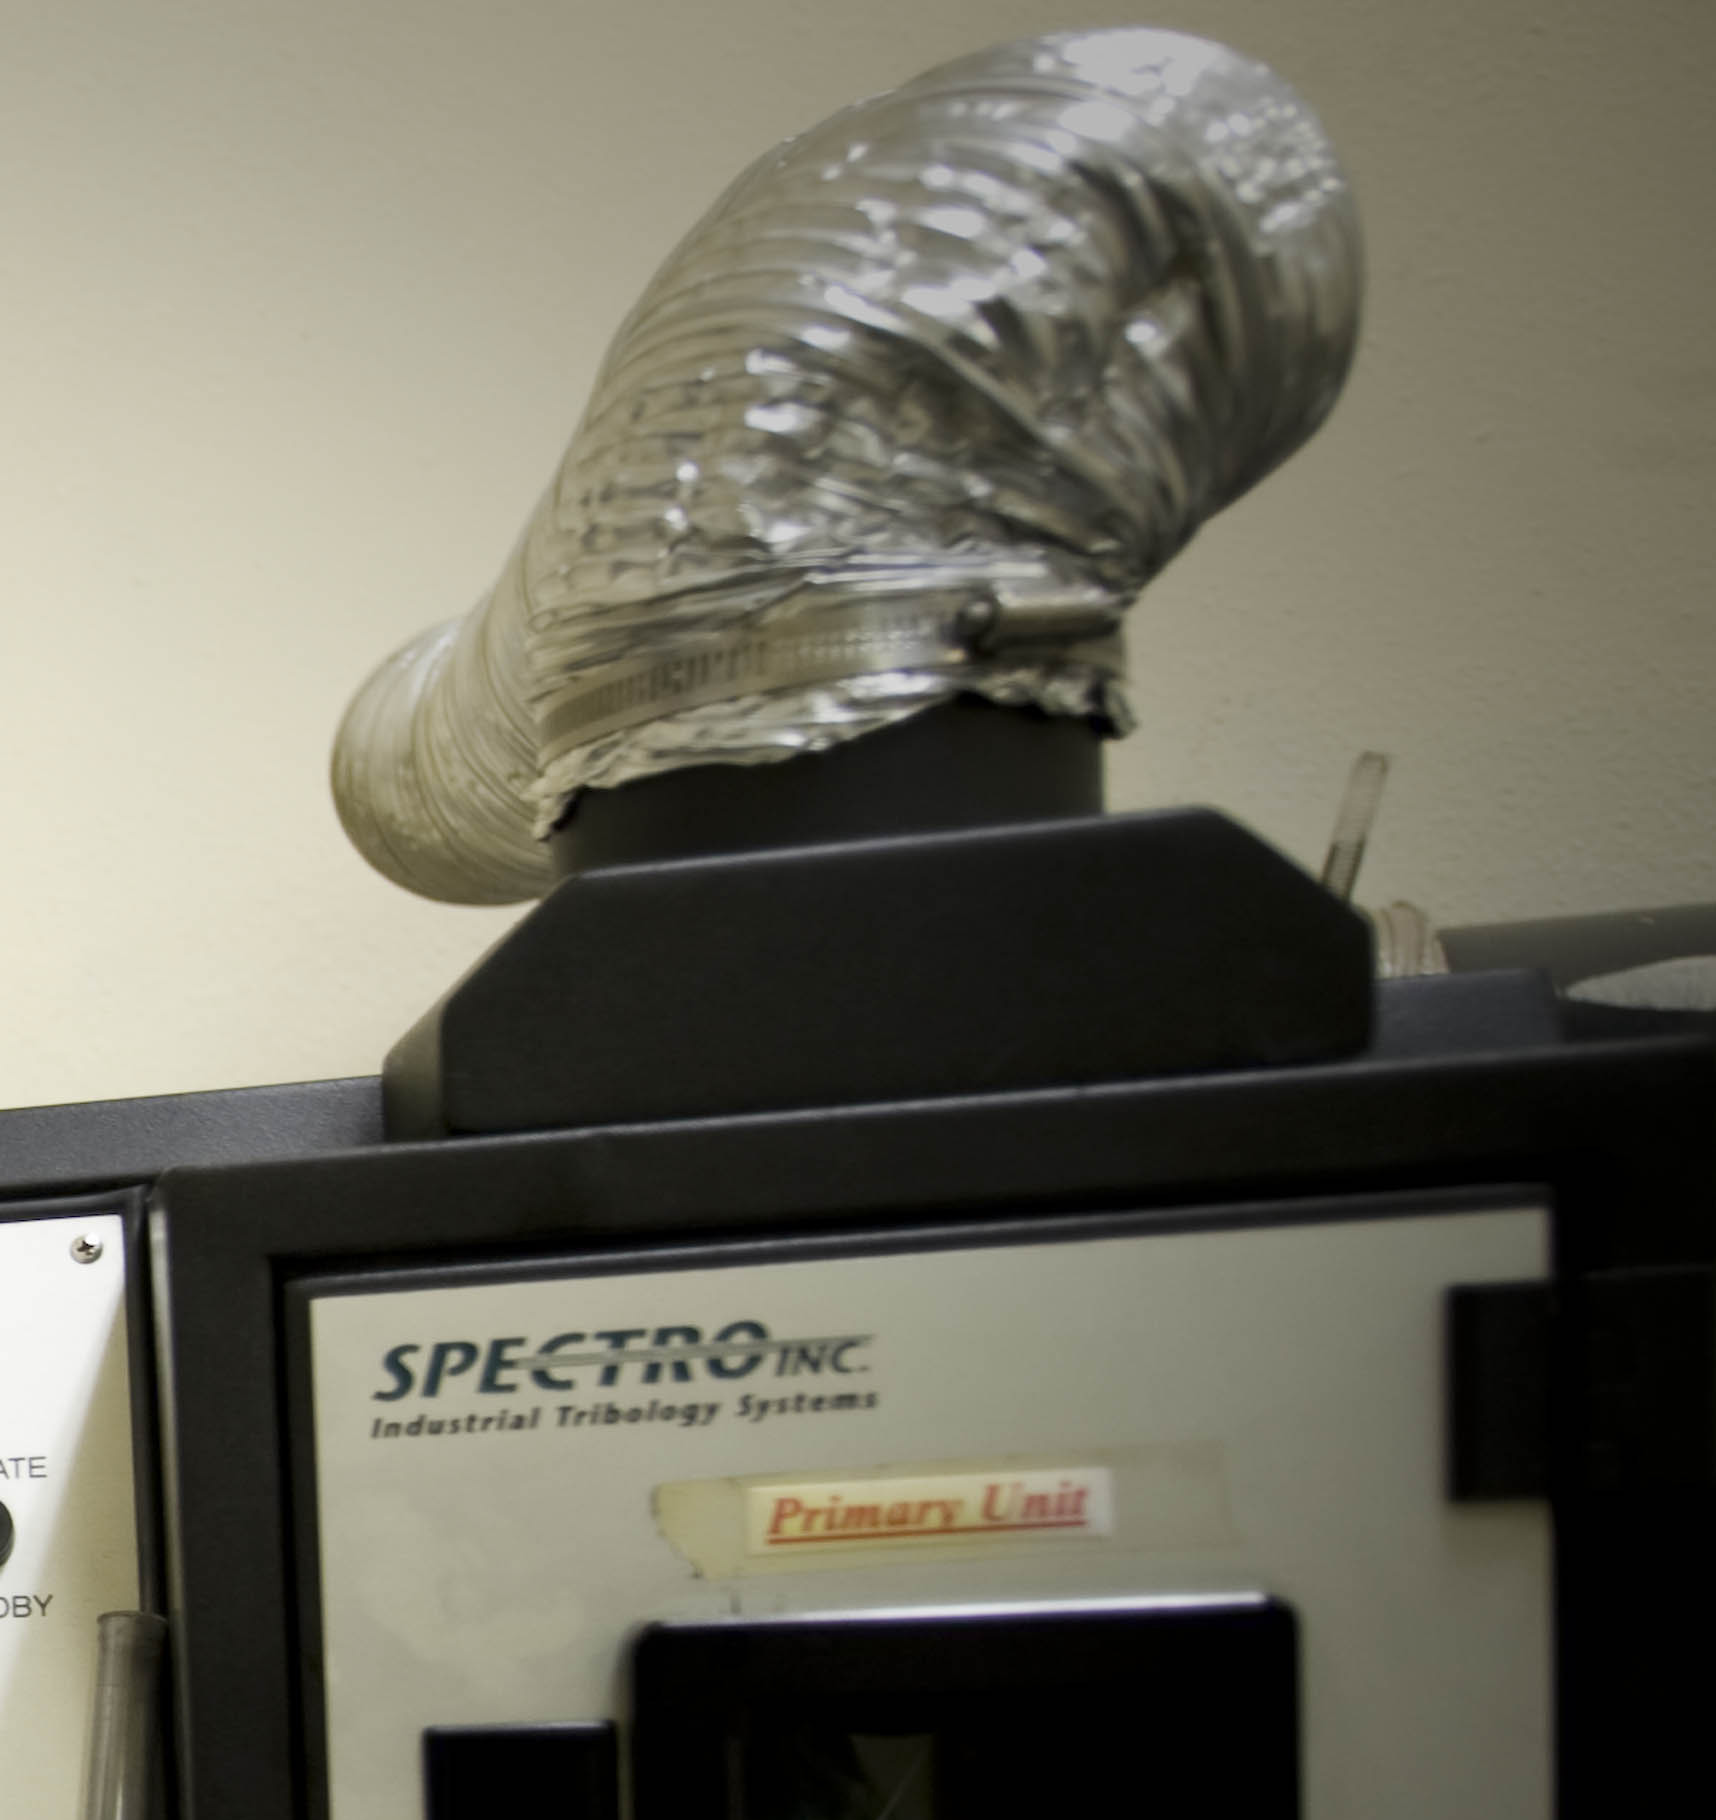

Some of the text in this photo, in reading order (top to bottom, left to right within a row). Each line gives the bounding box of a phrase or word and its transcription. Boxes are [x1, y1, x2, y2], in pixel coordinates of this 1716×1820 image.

[372, 1320, 869, 1401] SPECTRO INC.
[371, 1390, 878, 1439] Industrial Tribology Systems
[767, 1480, 1090, 1537] Primary Unit
